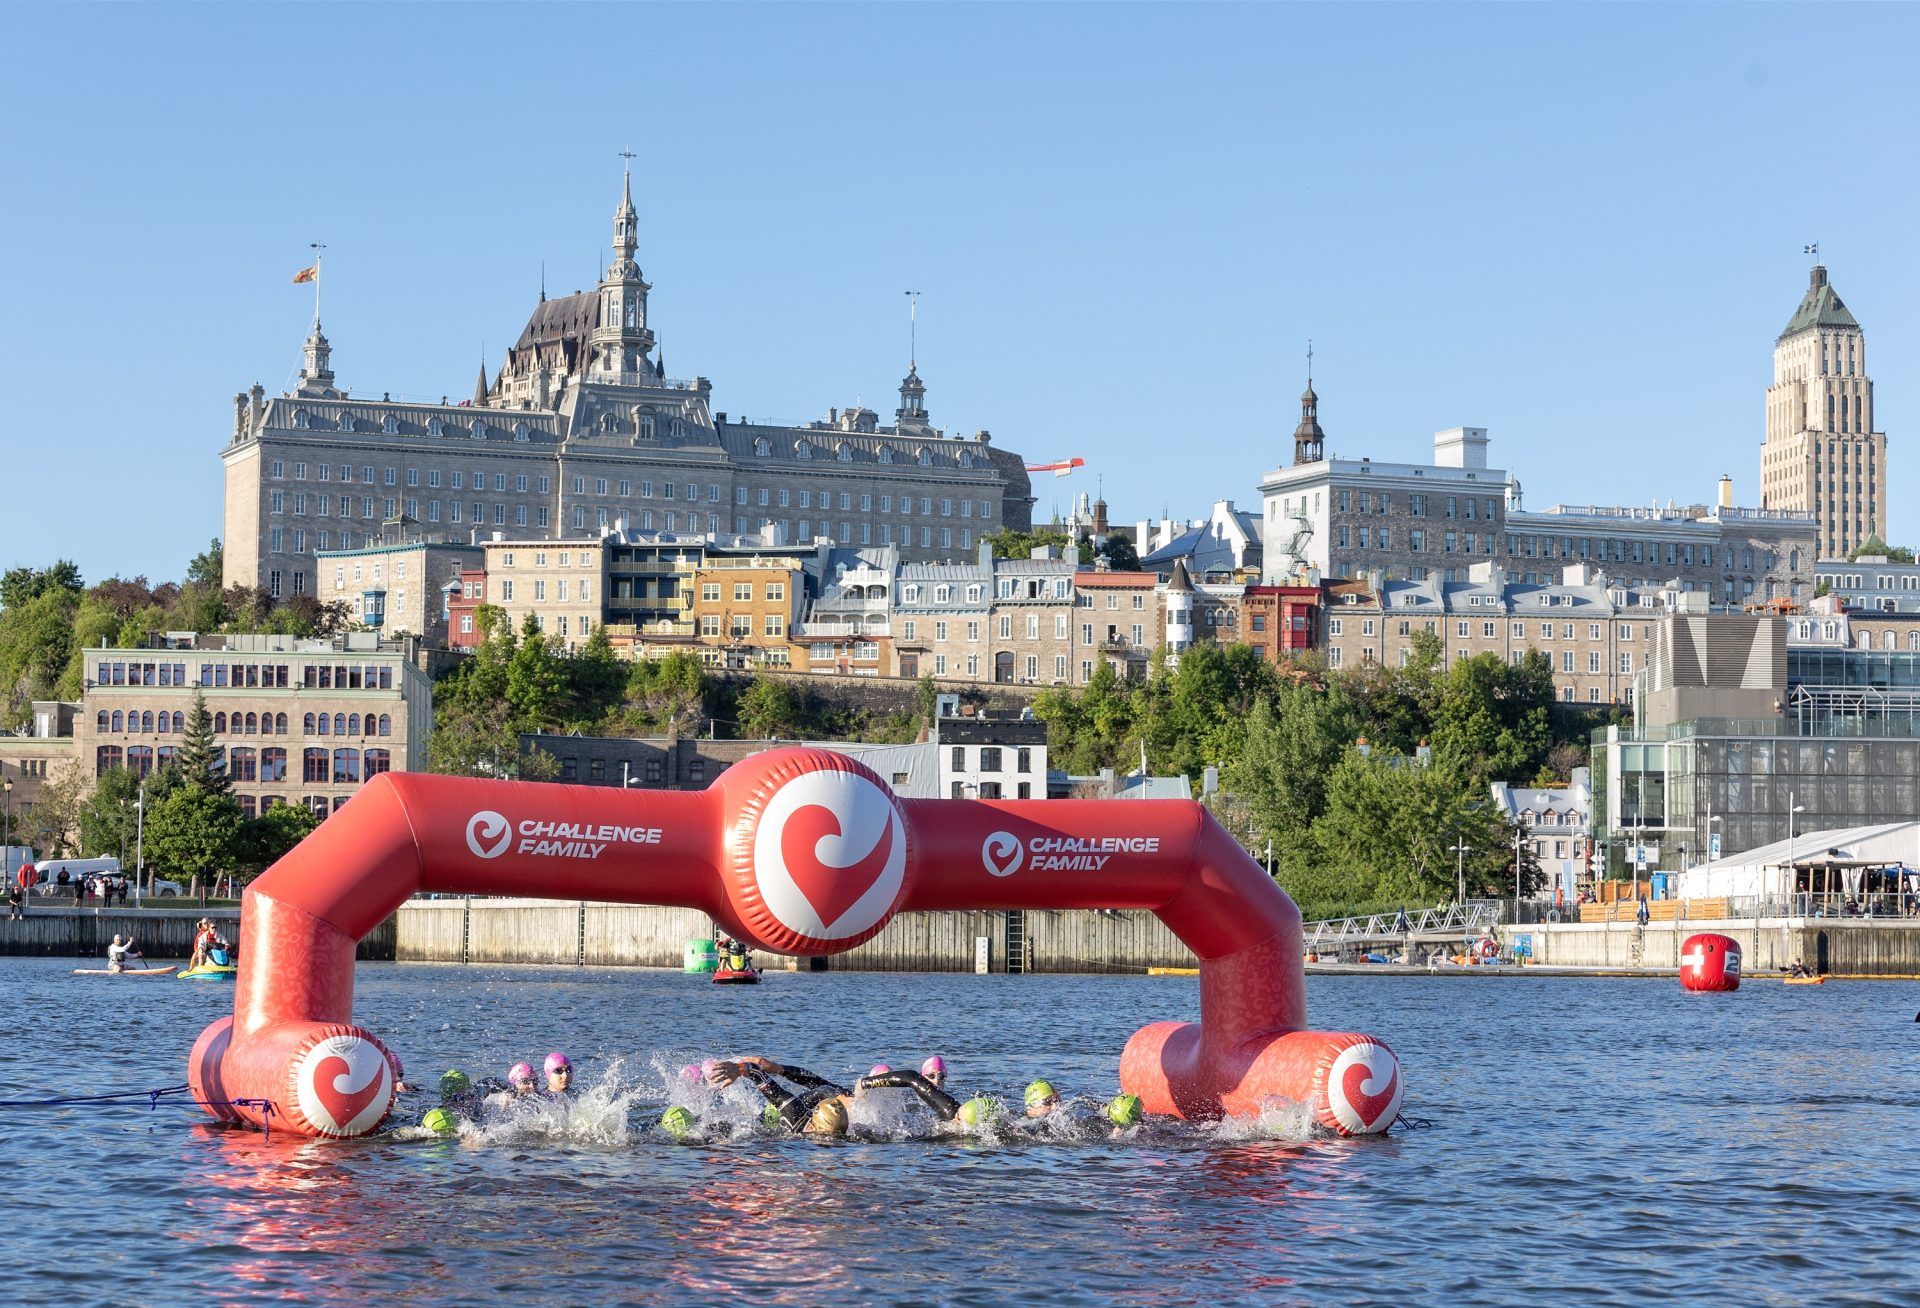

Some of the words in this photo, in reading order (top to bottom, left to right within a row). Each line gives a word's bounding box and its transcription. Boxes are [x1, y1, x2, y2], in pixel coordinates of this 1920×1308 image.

[519, 820, 662, 844] CHALLENGE
[518, 839, 606, 859] FAMILY
[1029, 837, 1160, 853] CHALLENGE
[1029, 855, 1111, 871] FAMILY
[1726, 956, 1739, 972] 2
